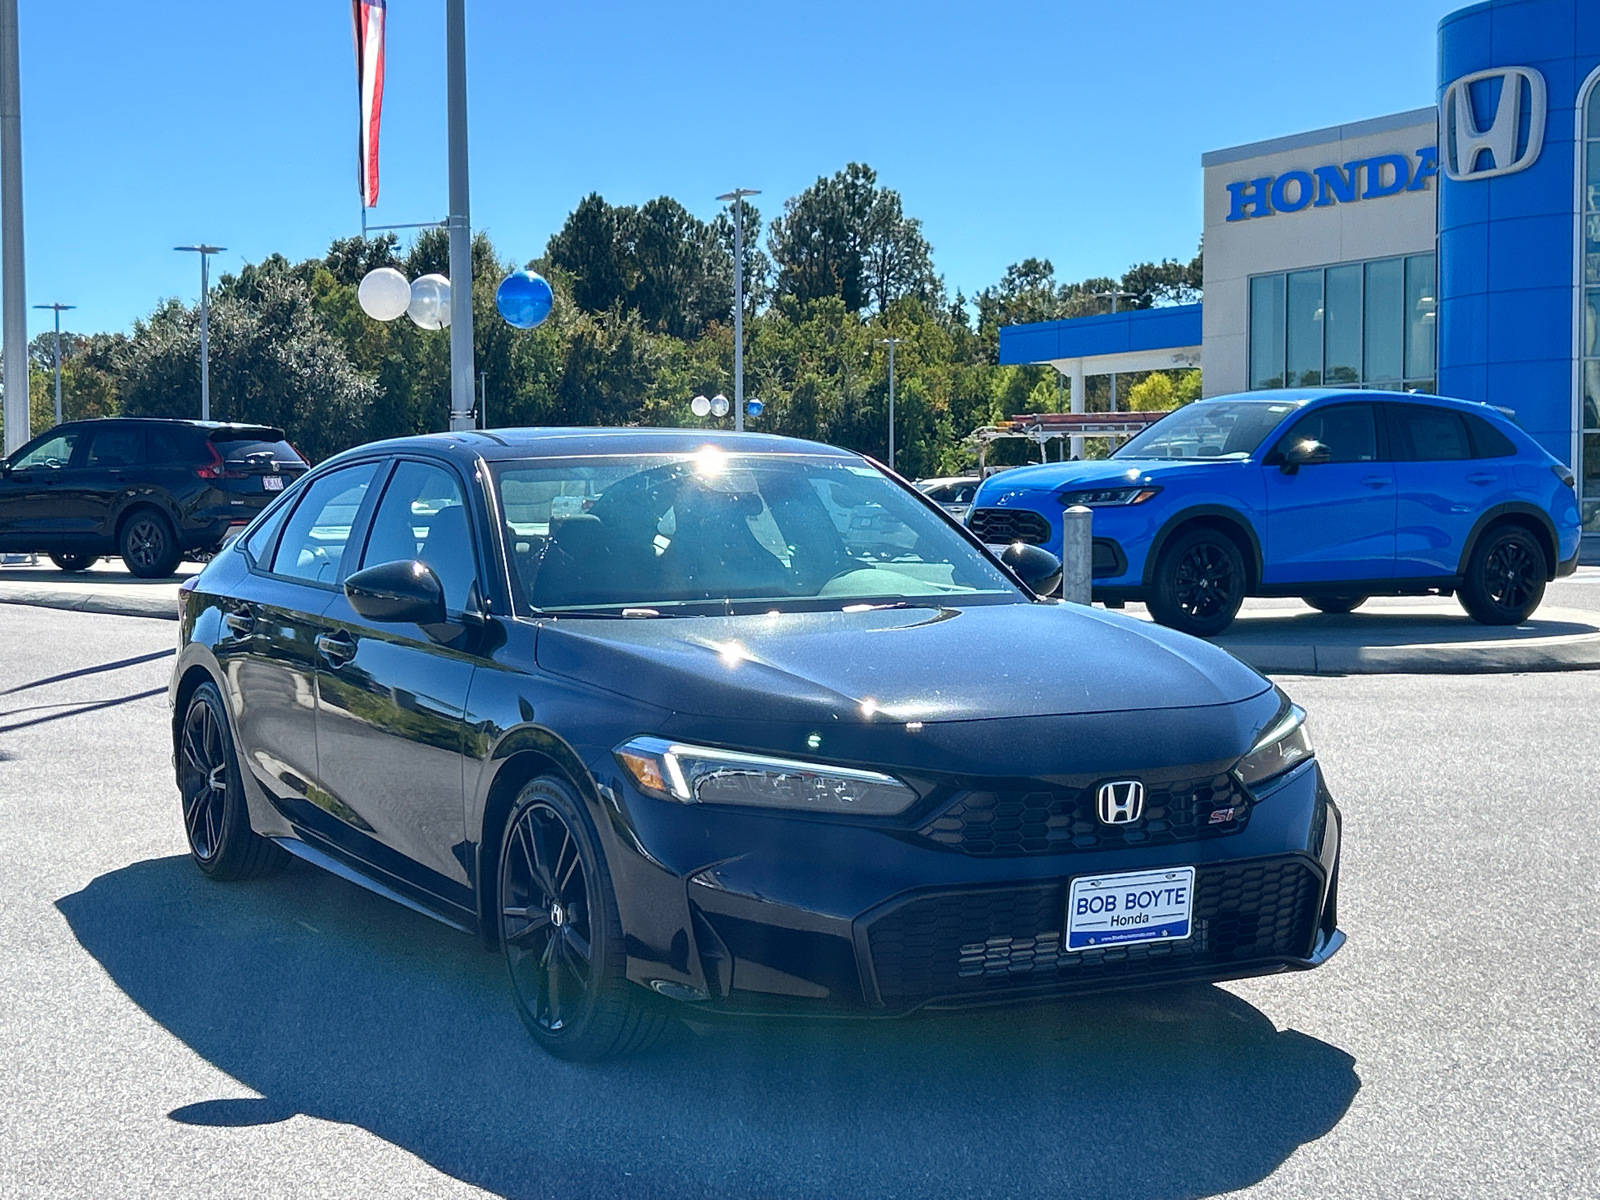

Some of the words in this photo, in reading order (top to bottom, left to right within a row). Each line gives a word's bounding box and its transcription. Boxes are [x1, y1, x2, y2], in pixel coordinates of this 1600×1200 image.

[1226, 147, 1437, 222] HONDA
[1208, 807, 1234, 824] Si
[1076, 894, 1117, 915] BOB
[1125, 887, 1187, 910] BOYTE
[1110, 912, 1149, 927] Honda
